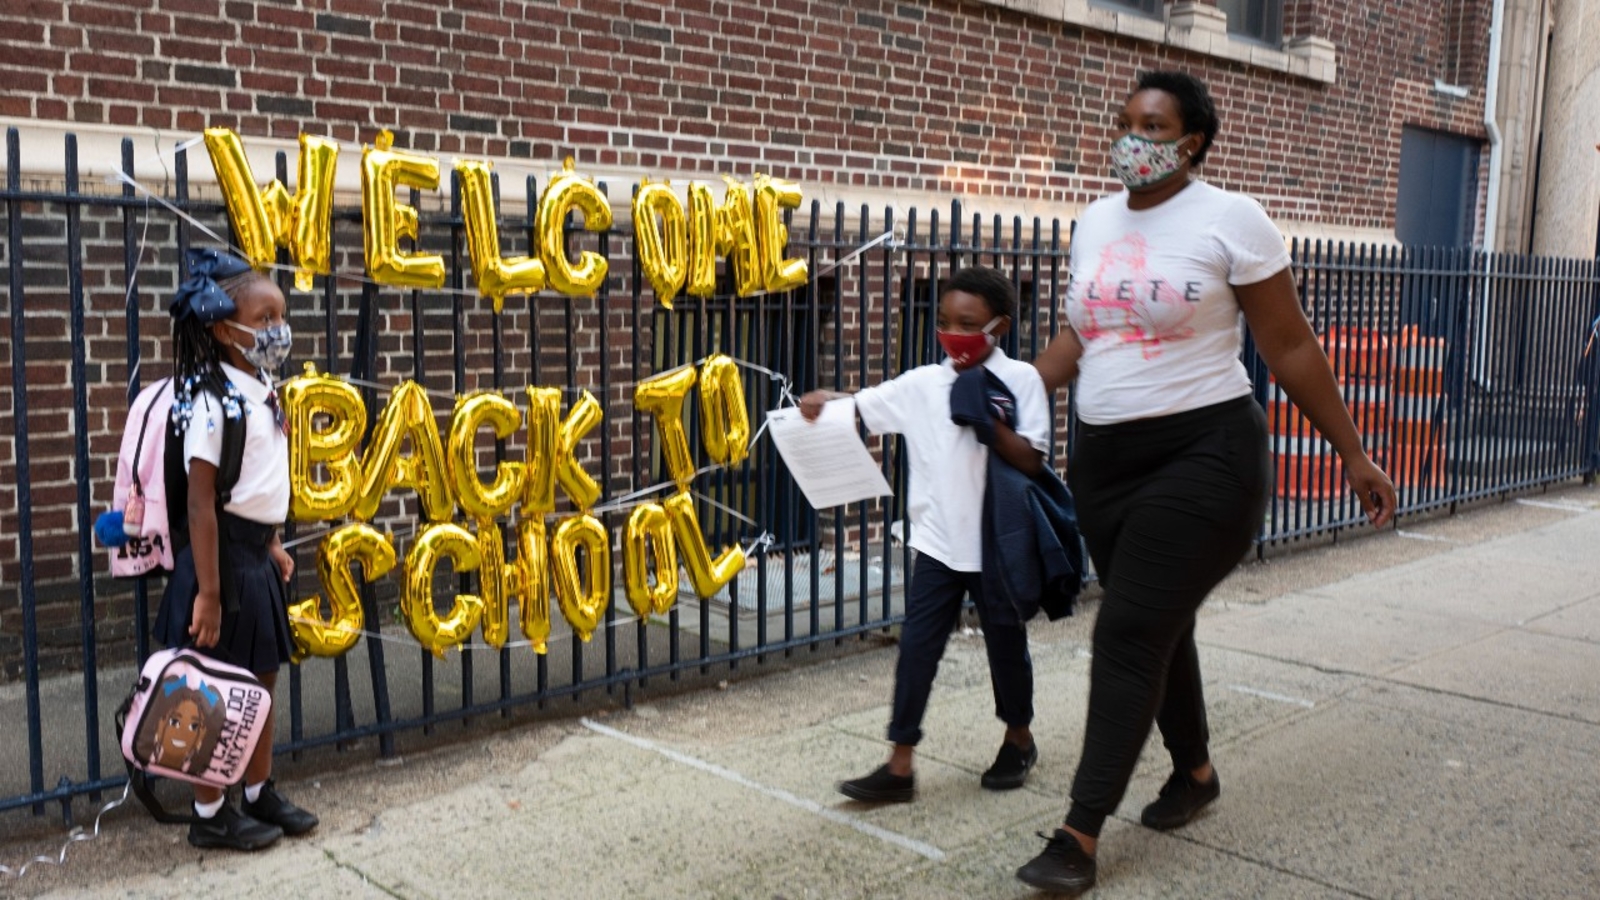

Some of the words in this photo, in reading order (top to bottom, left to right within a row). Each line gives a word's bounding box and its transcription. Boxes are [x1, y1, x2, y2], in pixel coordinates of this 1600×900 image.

[203, 127, 809, 310] WELCOME
[284, 362, 604, 523] BACK
[633, 353, 752, 492] TO
[287, 490, 747, 664] SCHOOL
[209, 719, 238, 760] CAN
[227, 686, 246, 712] DO
[220, 689, 262, 778] ANYTHING
